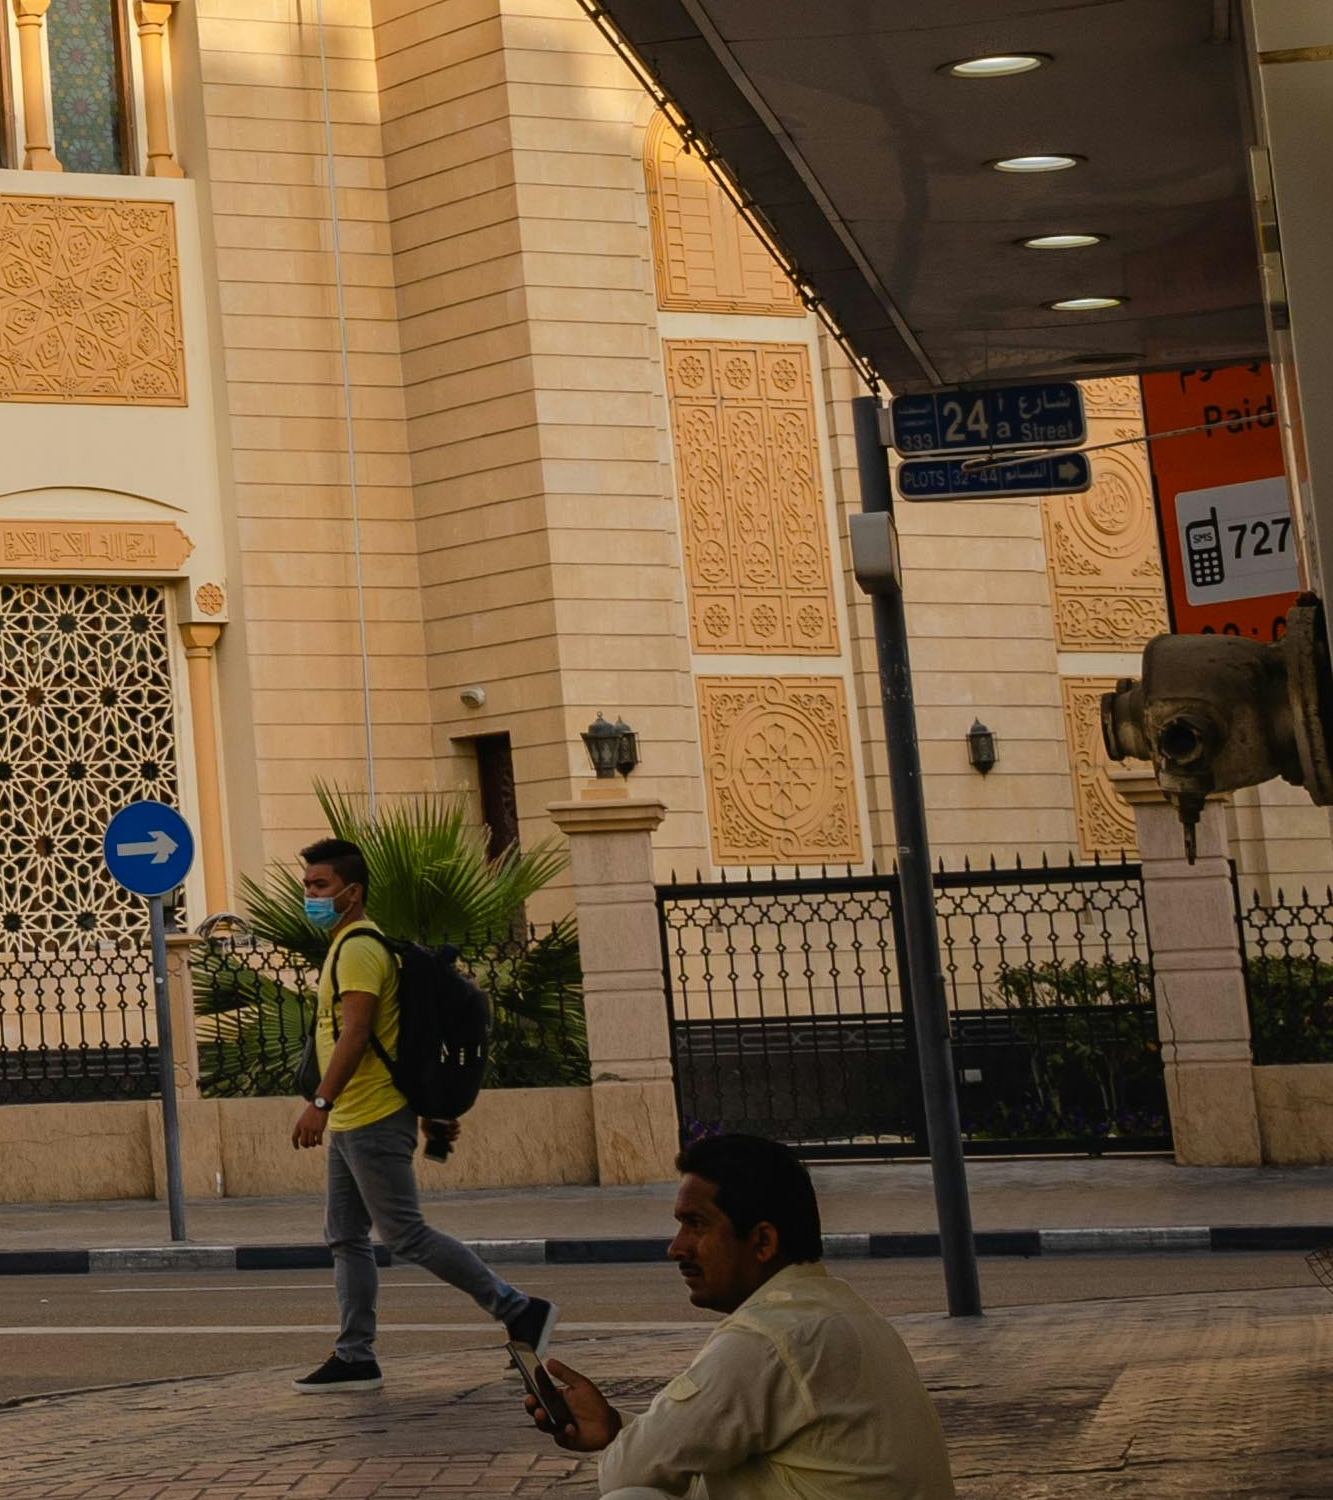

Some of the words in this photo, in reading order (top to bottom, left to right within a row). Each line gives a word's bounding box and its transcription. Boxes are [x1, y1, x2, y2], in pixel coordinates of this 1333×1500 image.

[1018, 391, 1071, 419] شارع
[1203, 395, 1276, 438] Paid
[942, 398, 989, 443] 24
[997, 420, 1012, 439] a
[1020, 419, 1074, 442] Street
[901, 433, 934, 451] 333
[904, 469, 946, 489] PLOTS
[953, 467, 998, 486] 32-44
